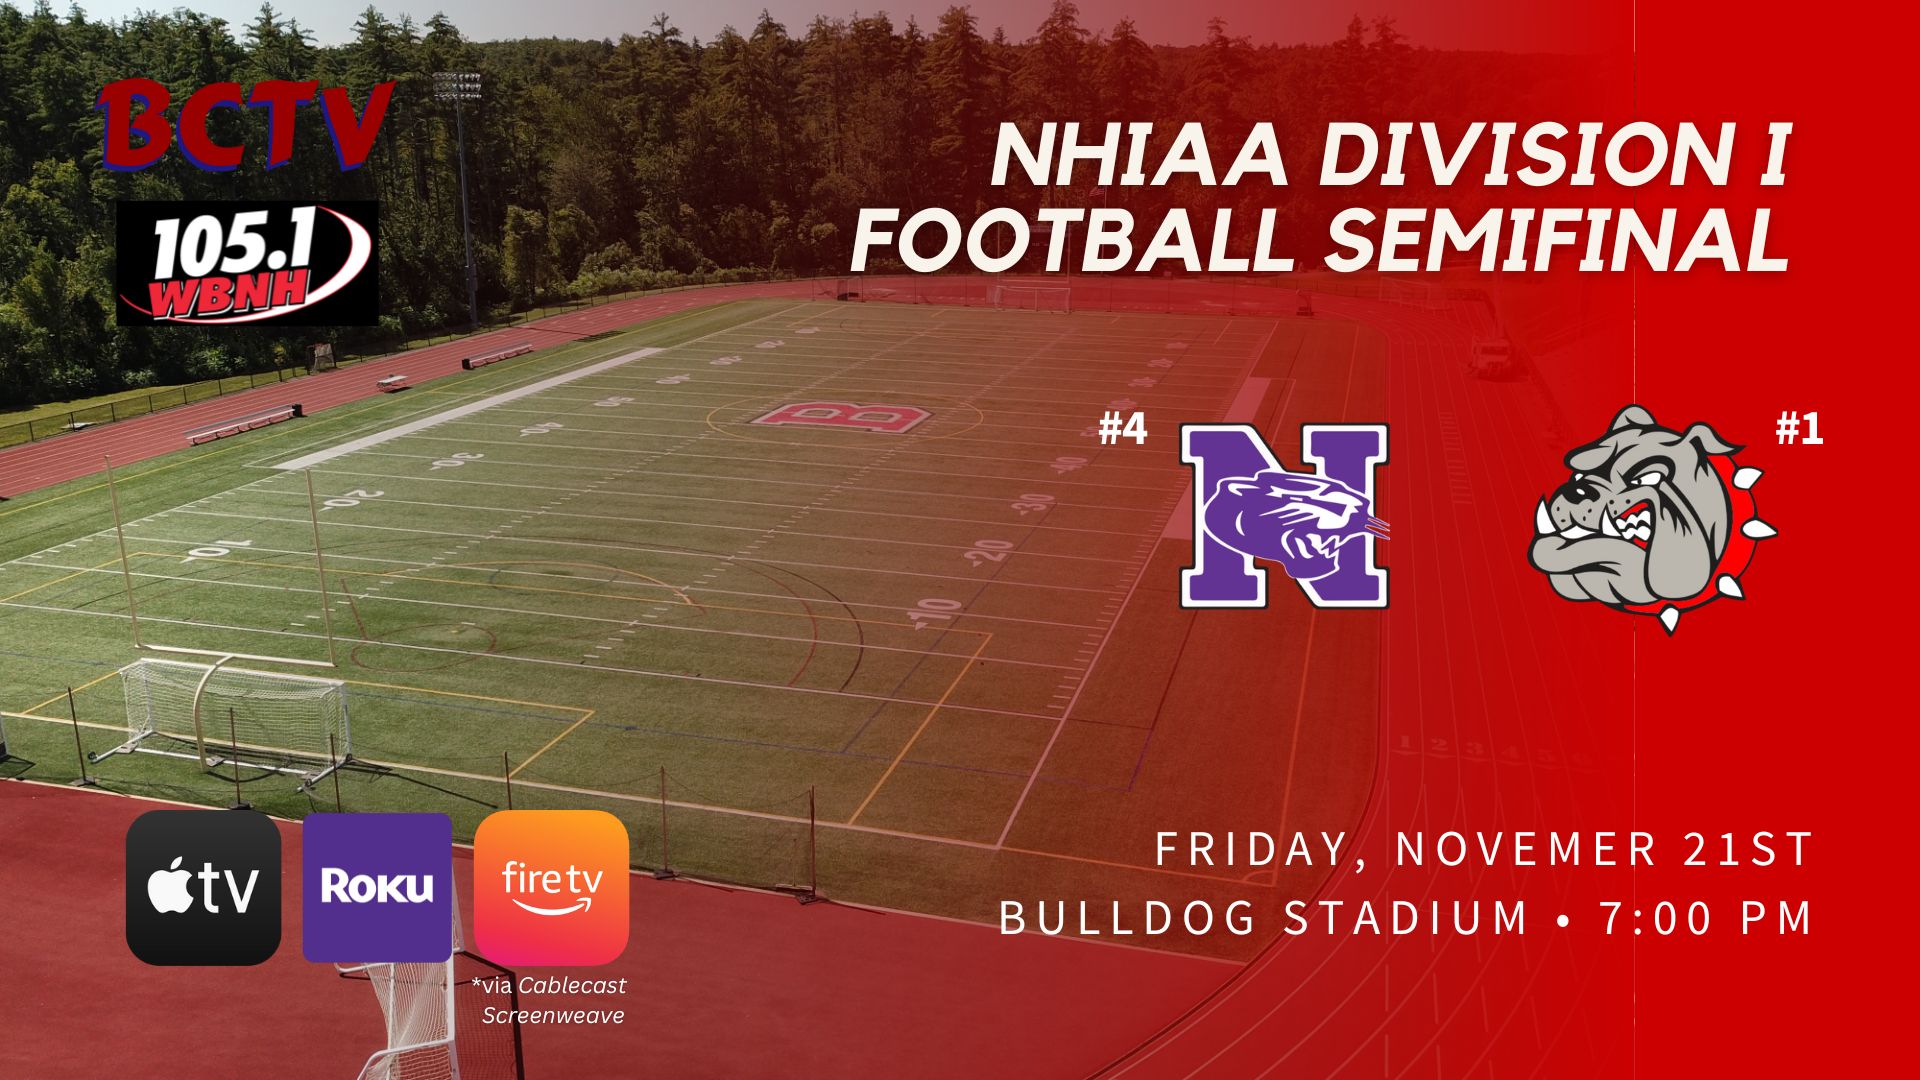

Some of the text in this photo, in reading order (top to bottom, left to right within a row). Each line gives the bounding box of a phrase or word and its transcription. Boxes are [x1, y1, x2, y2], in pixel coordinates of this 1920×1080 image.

[747, 400, 935, 435] B
[431, 452, 485, 469] 30
[323, 489, 385, 508] 20
[1010, 493, 1055, 512] 30
[187, 539, 254, 559] 10
[963, 539, 1014, 563] 20
[906, 598, 962, 620] 10
